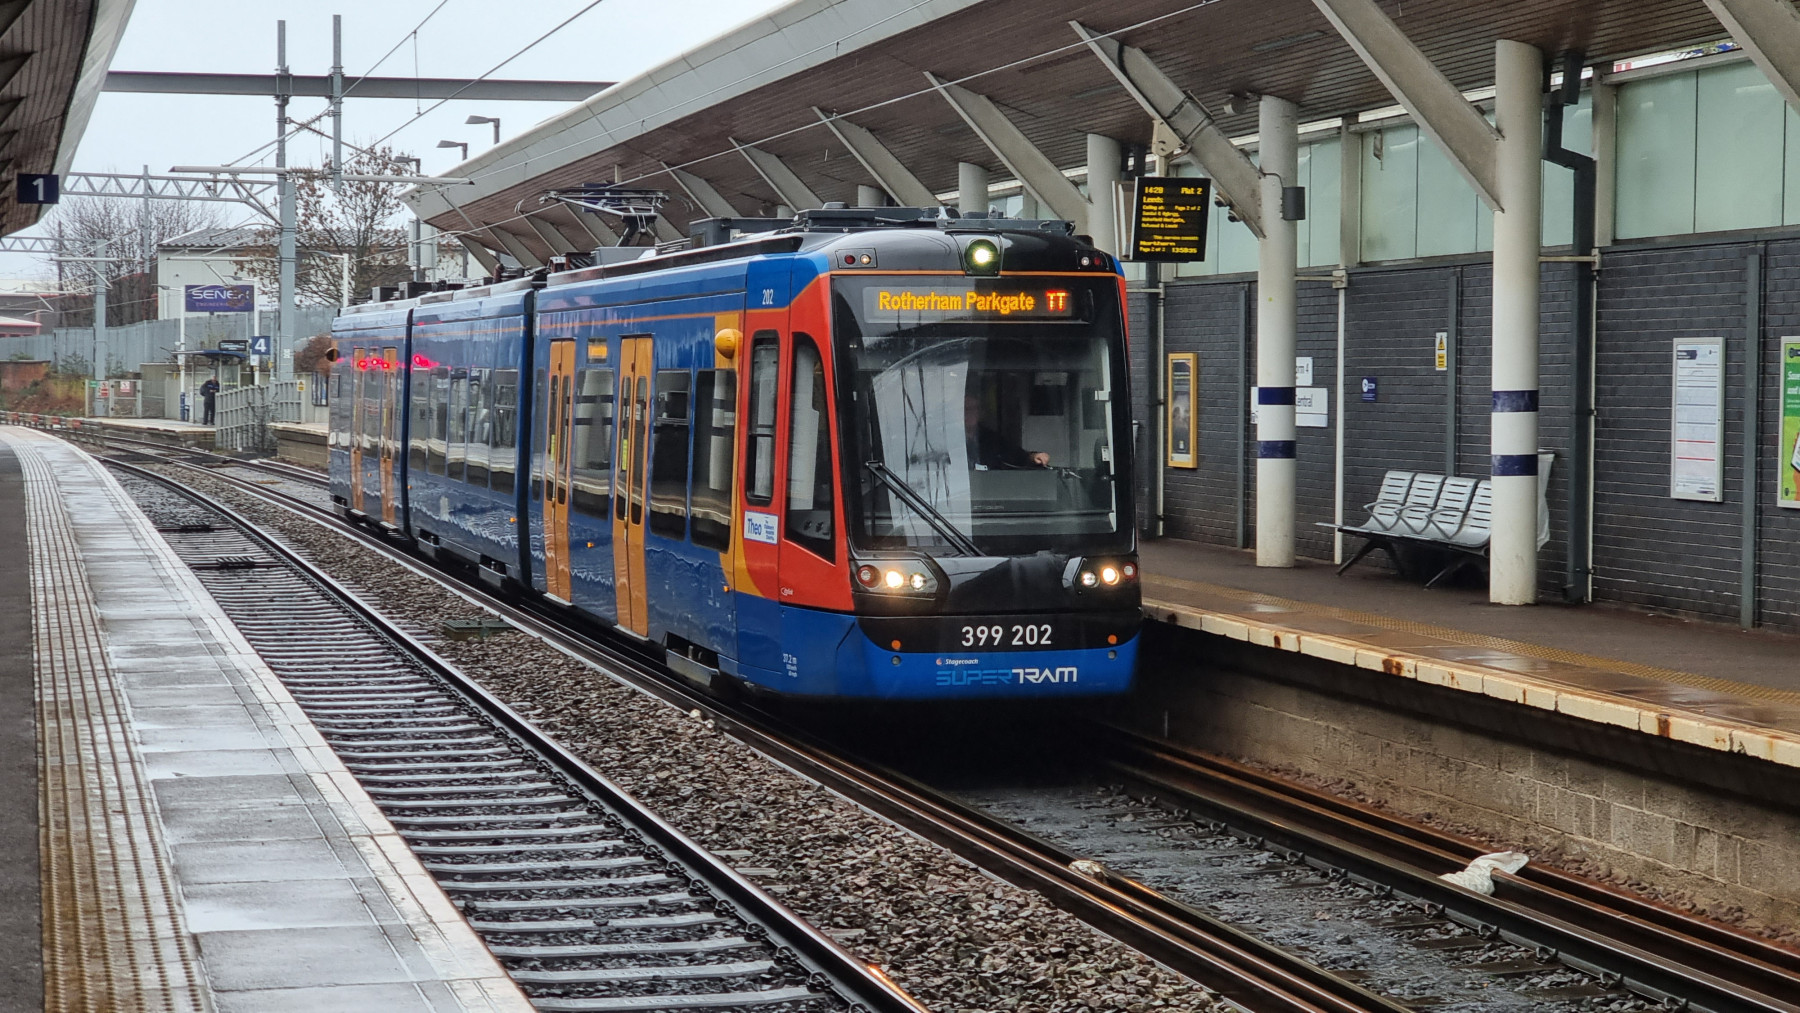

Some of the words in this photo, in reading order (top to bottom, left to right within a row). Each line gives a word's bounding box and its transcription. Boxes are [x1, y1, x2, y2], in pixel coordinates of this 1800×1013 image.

[32, 178, 44, 201] 1
[762, 288, 774, 305] 202
[878, 291, 962, 311] Rotherham
[965, 291, 1035, 315] Parkgate
[1045, 290, 1068, 312] TT
[254, 338, 267, 353] 4
[1296, 394, 1313, 408] entral
[747, 518, 762, 536] Theo
[961, 625, 1003, 647] 399
[1011, 624, 1052, 646] 202
[945, 658, 979, 666] Stagecoach
[936, 667, 1078, 686] SUPERTRAM
